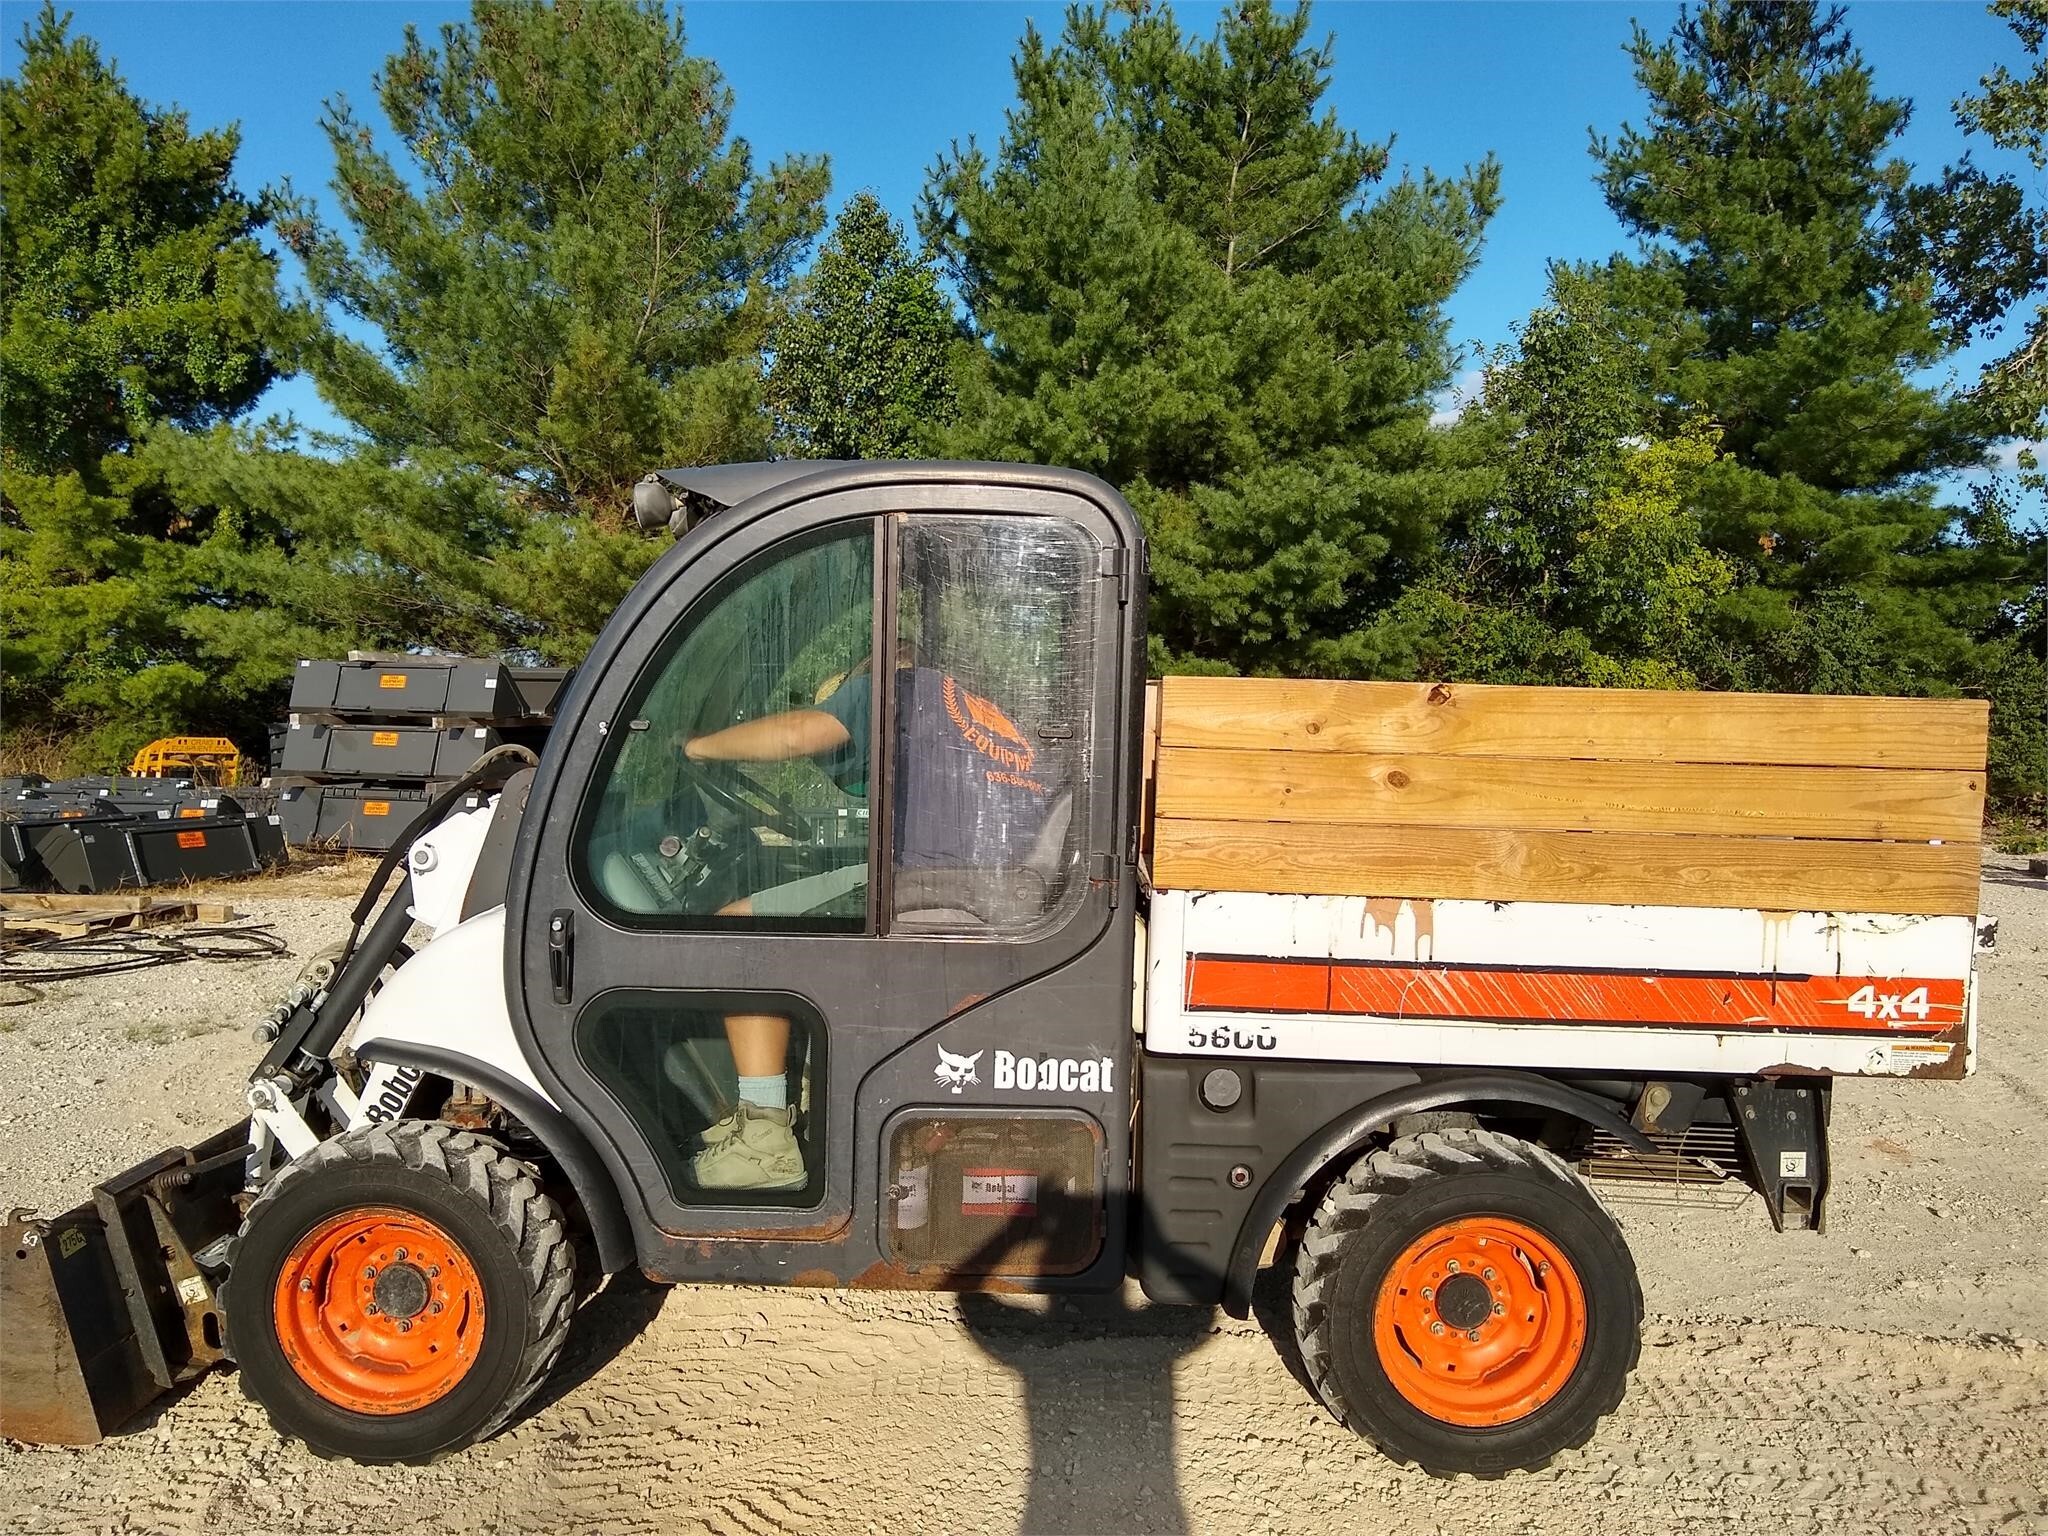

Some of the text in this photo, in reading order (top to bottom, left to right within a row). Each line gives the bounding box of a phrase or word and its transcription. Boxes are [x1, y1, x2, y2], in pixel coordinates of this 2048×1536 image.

[1847, 985, 1931, 1020] 4x4
[1188, 1025, 1277, 1050] 5600
[993, 1050, 1114, 1093] Bobcat
[985, 1182, 1016, 1193] Bobat
